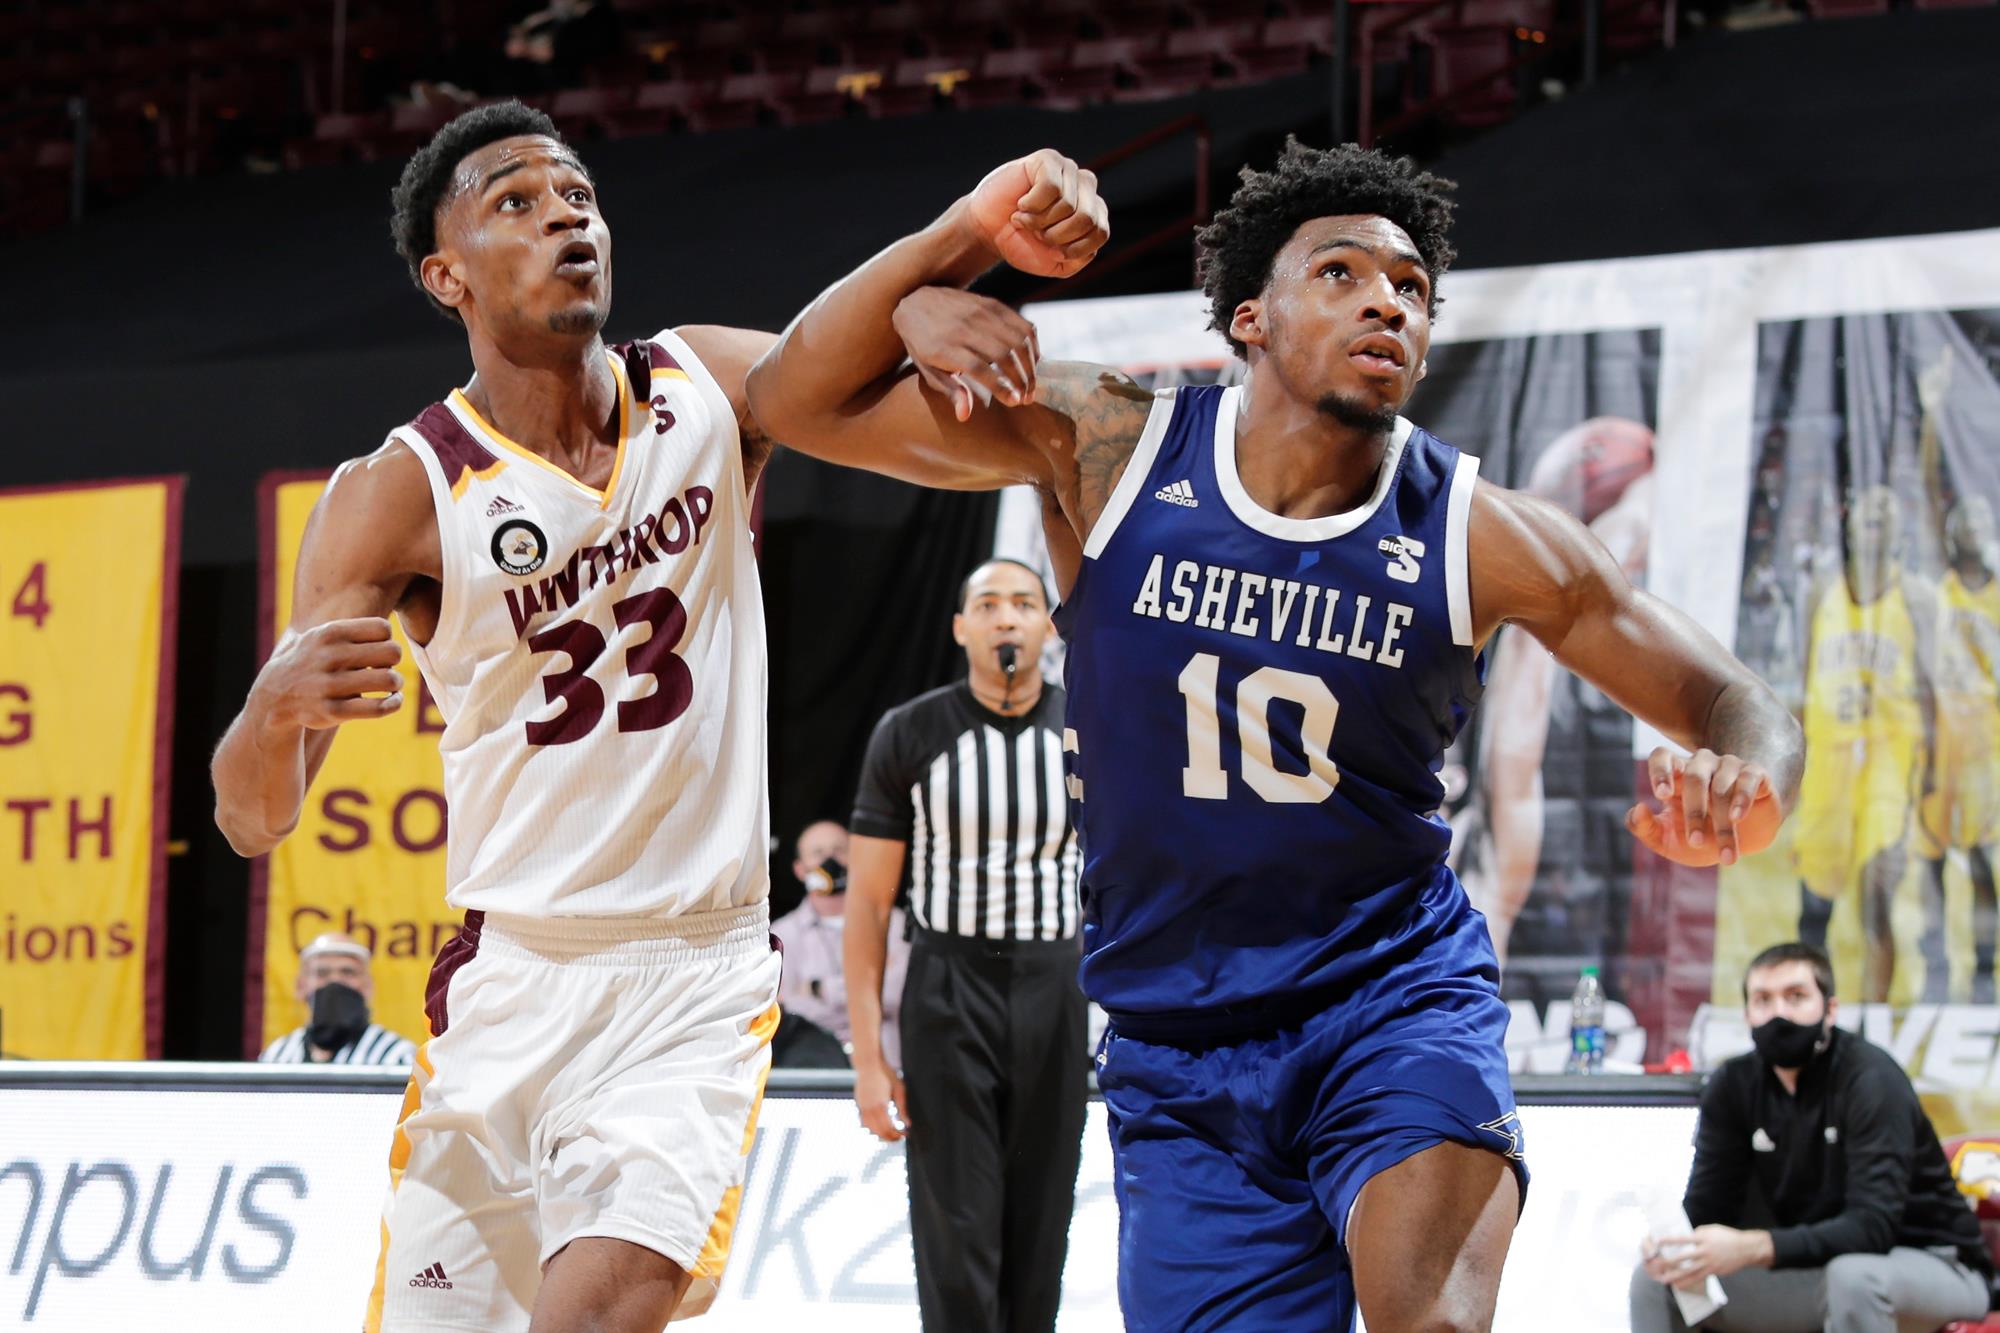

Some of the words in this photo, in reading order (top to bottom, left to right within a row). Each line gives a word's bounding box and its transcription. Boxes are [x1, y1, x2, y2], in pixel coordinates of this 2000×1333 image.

[1154, 490, 1199, 508] adidas
[503, 485, 714, 641] WNTHROP
[1378, 539, 1404, 556] BIG
[1132, 554, 1414, 668] ASHEVILLE
[525, 586, 694, 747] 33
[1177, 651, 1341, 804] 10
[6, 795, 113, 863] TH
[409, 1276, 453, 1290] adidas
